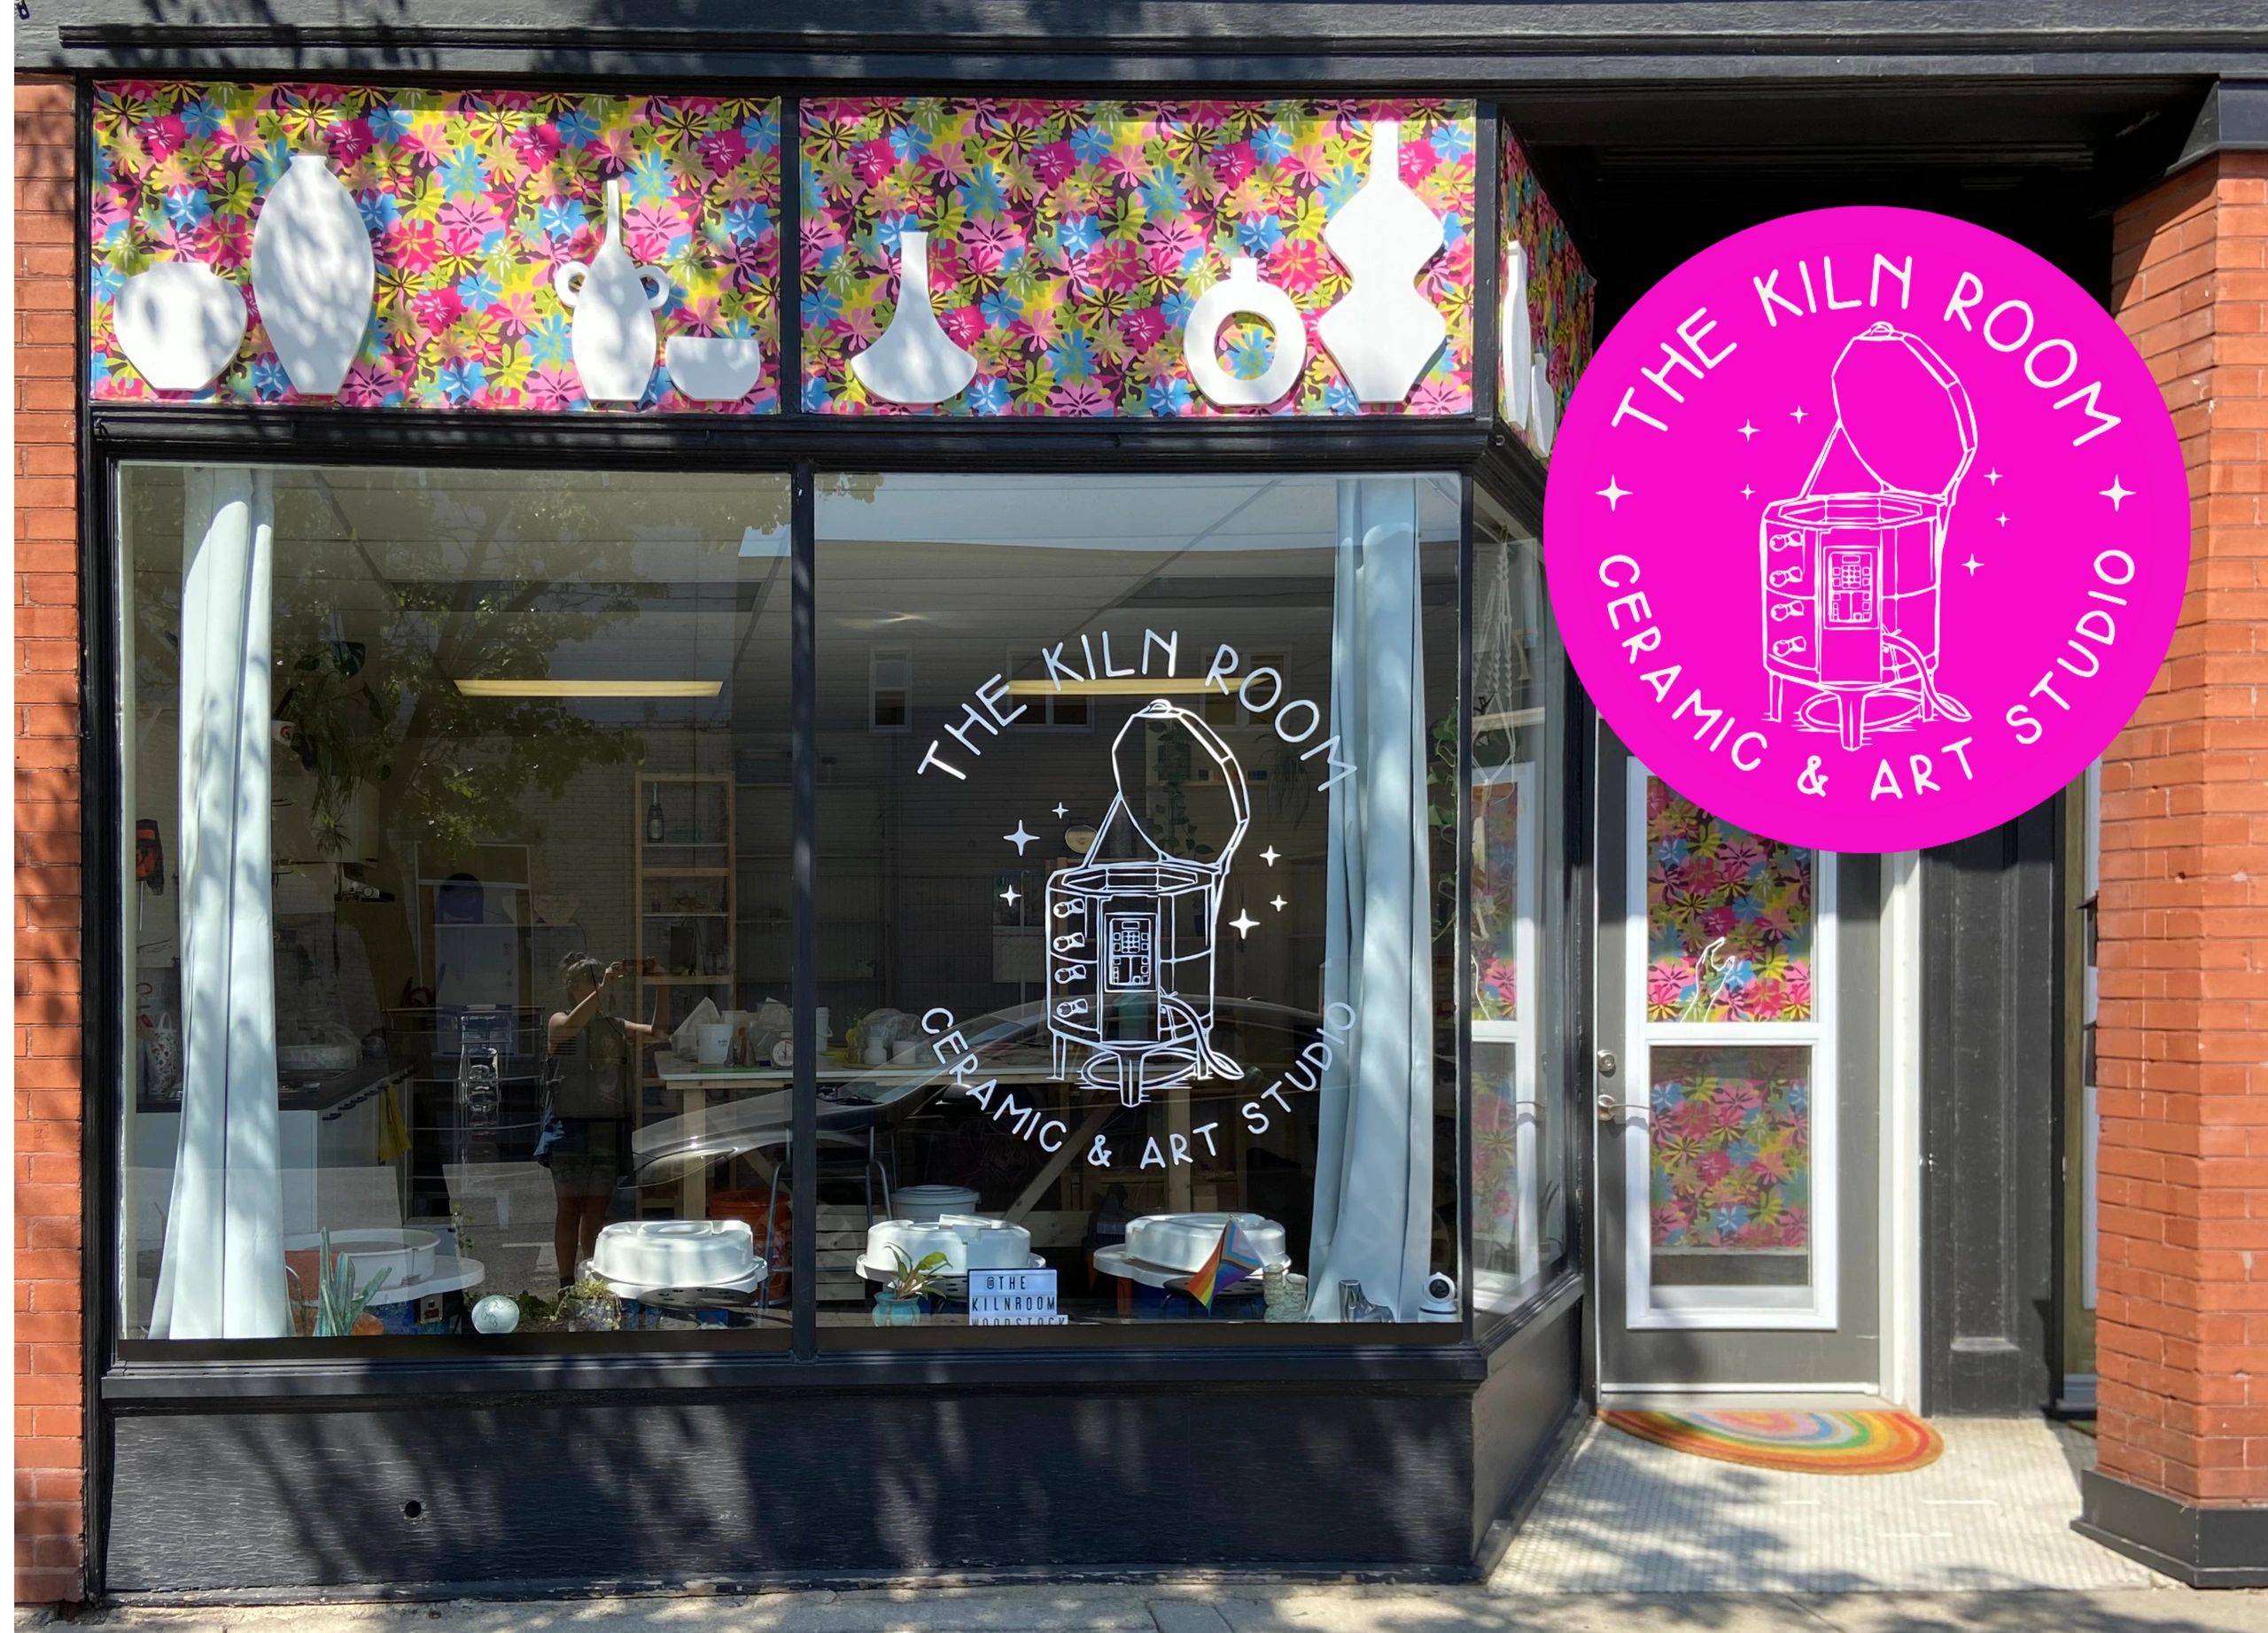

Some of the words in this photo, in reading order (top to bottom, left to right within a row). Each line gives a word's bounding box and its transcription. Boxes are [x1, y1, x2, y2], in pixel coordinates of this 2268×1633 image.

[918, 673, 1028, 780] THE
[1042, 628, 1177, 692] KILN
[1205, 643, 1356, 791] ROOM
[921, 1007, 1067, 1152] CERAMIC
[1088, 1134, 1111, 1167] &
[1139, 1122, 1217, 1169] ART
[1242, 1002, 1356, 1134] STUDIO
[972, 1296, 1055, 1311] KILNROOM
